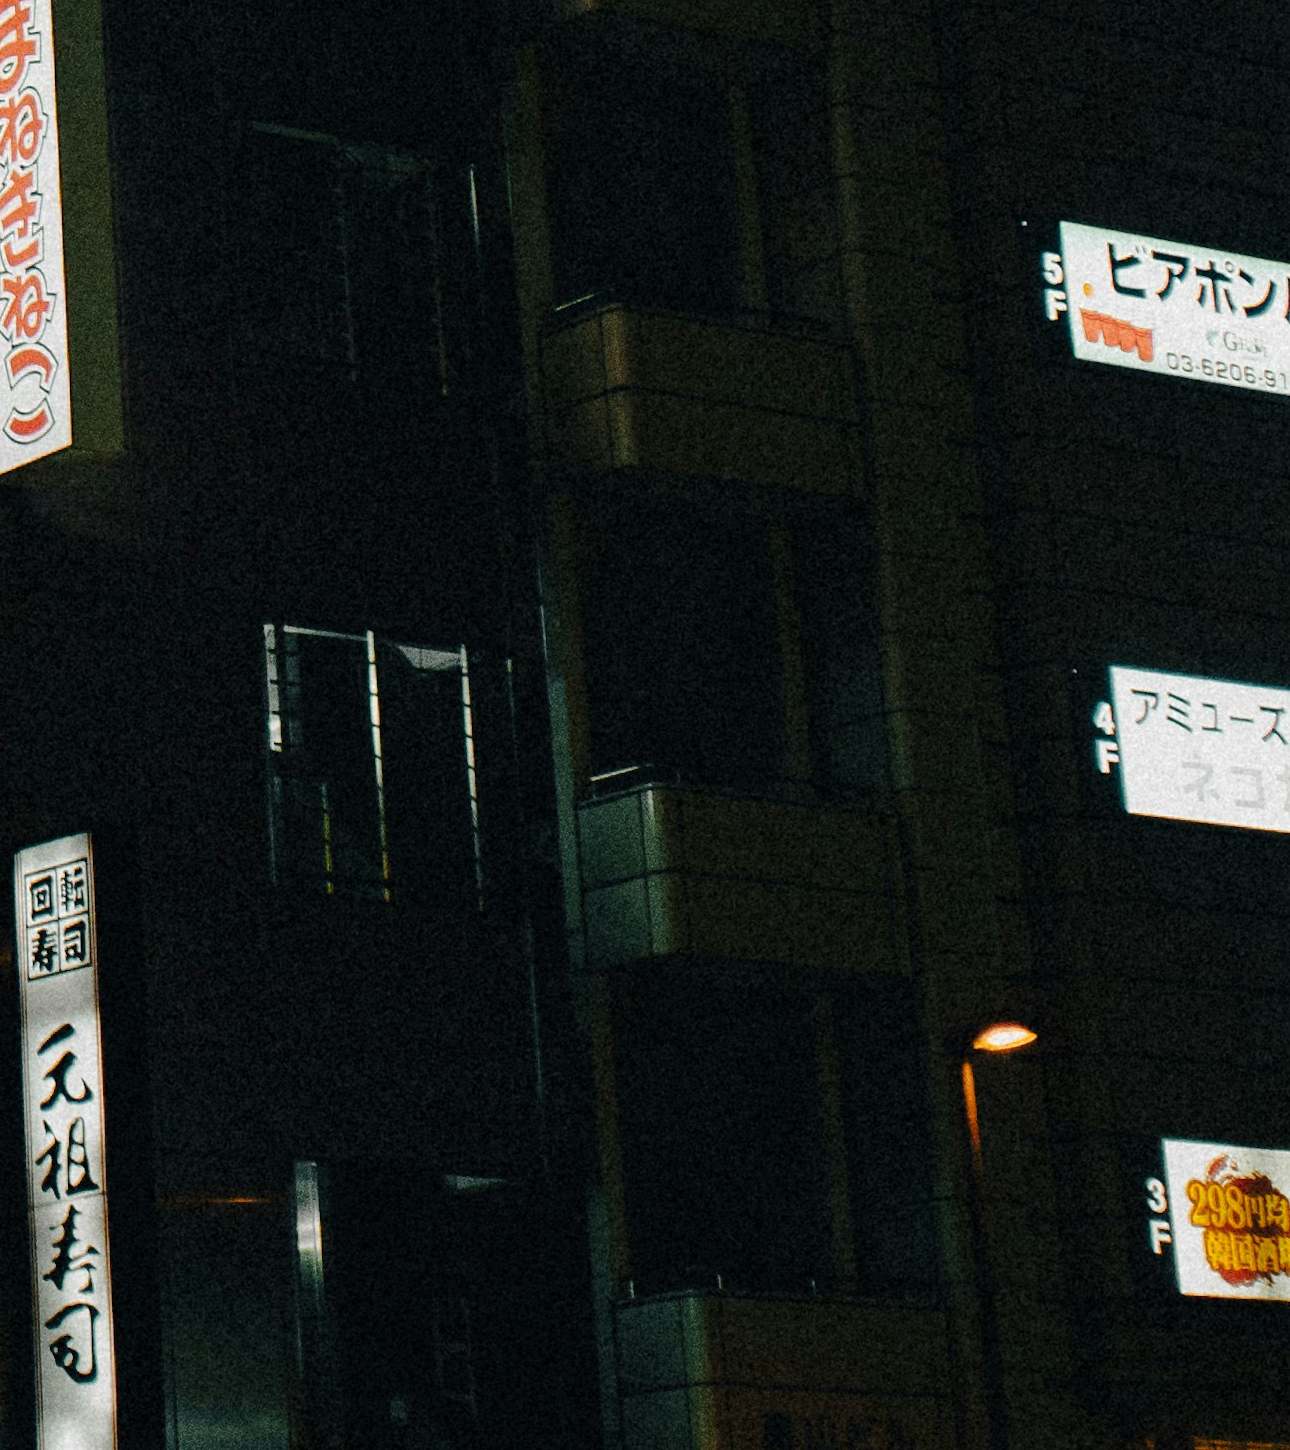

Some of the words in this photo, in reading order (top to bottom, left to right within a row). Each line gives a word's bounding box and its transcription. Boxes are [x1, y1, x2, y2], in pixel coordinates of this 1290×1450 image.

[29, 865, 85, 922] 回転
[31, 918, 88, 974] 寿司
[35, 1022, 106, 1384] 元祖寿司
